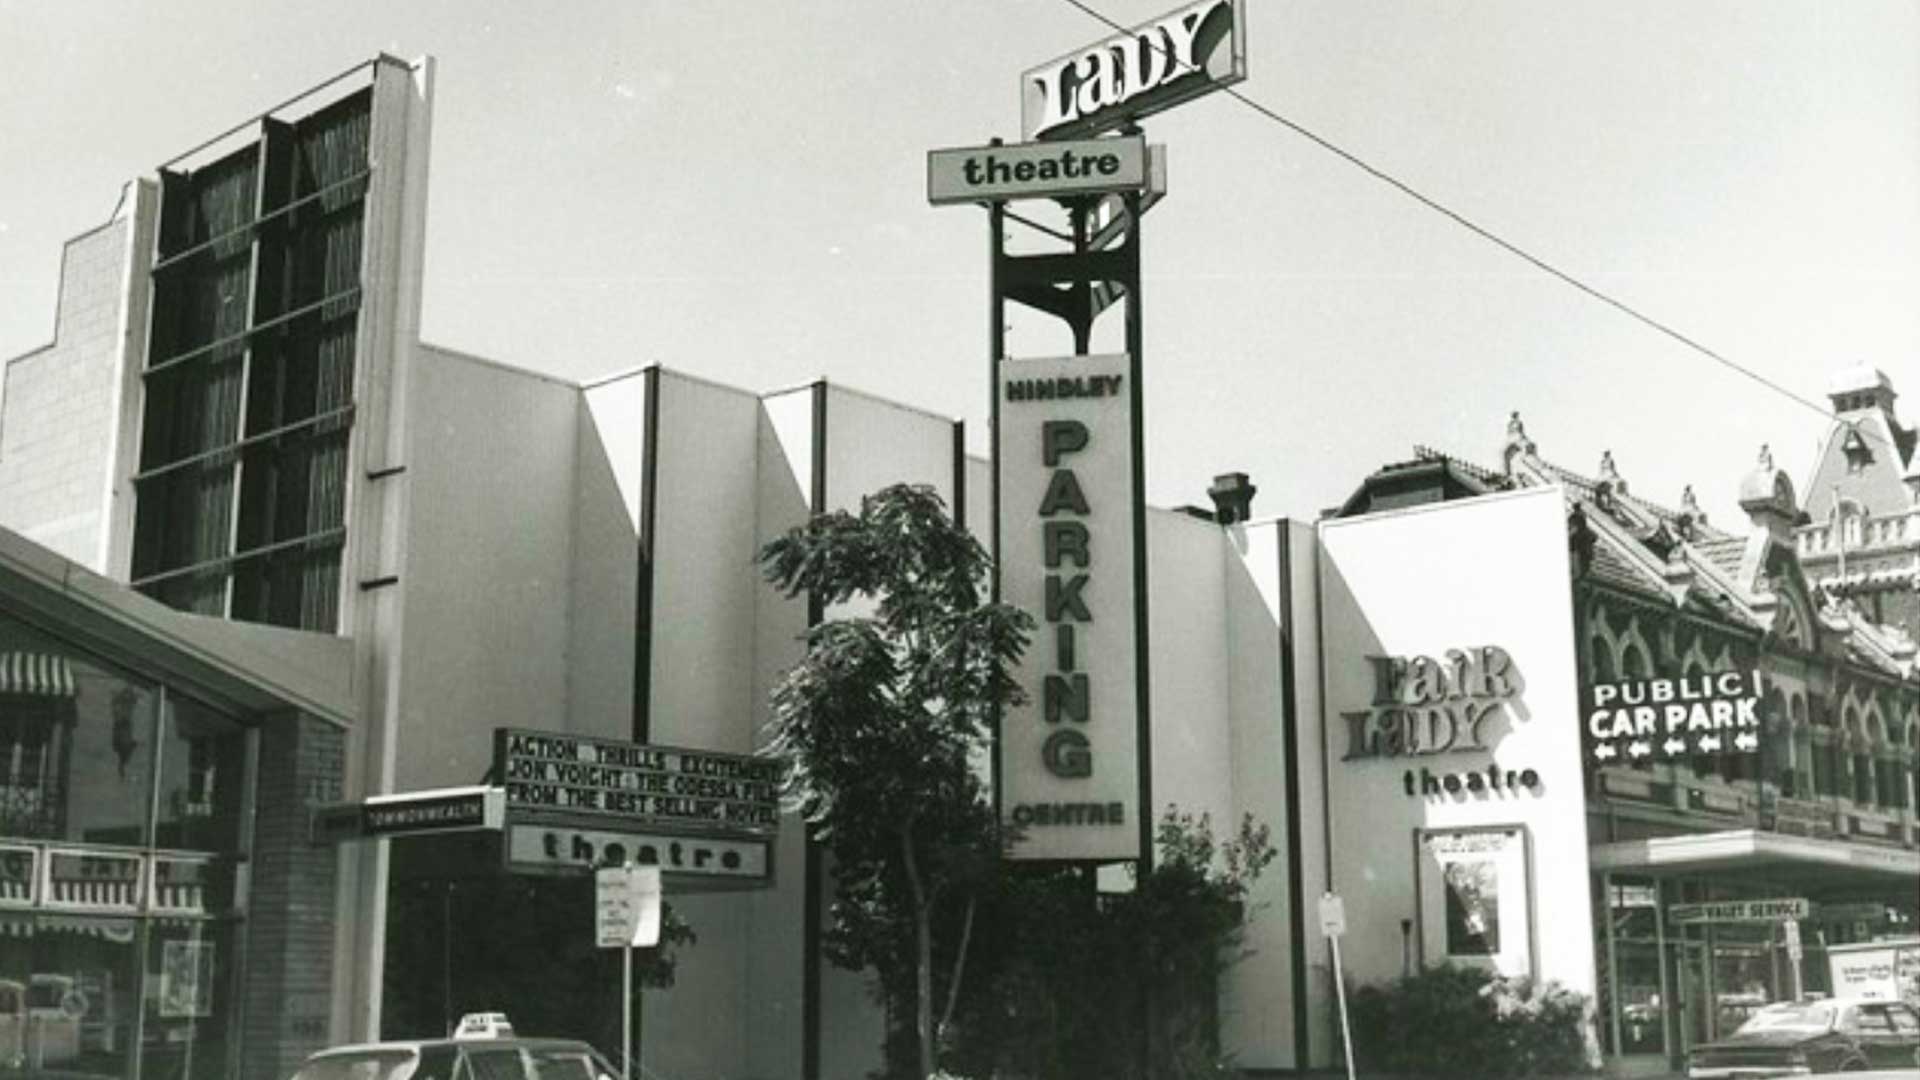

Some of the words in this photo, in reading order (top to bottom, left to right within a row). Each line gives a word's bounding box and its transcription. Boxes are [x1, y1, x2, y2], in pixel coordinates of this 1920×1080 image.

[962, 150, 1121, 185] theatre
[1006, 374, 1122, 403] HINDLEY
[1038, 419, 1093, 779] PARKING
[1594, 672, 1743, 707] PUBLIC
[1589, 706, 1657, 739] CAR
[1664, 697, 1760, 733] PARK
[509, 735, 578, 760] ACTION
[595, 744, 665, 770] THRILLS
[508, 760, 546, 780] JON
[555, 764, 622, 788] VOIGHT
[638, 772, 669, 792] THE
[675, 776, 738, 798] ODESSA
[1403, 764, 1539, 796] theatre
[507, 784, 557, 804] FROM
[564, 788, 600, 808] THE
[604, 791, 647, 813] BEST
[654, 796, 720, 819] SELLING
[726, 802, 778, 824] NOVEL
[1011, 802, 1123, 827] CENTRE
[543, 833, 741, 869] theatre
